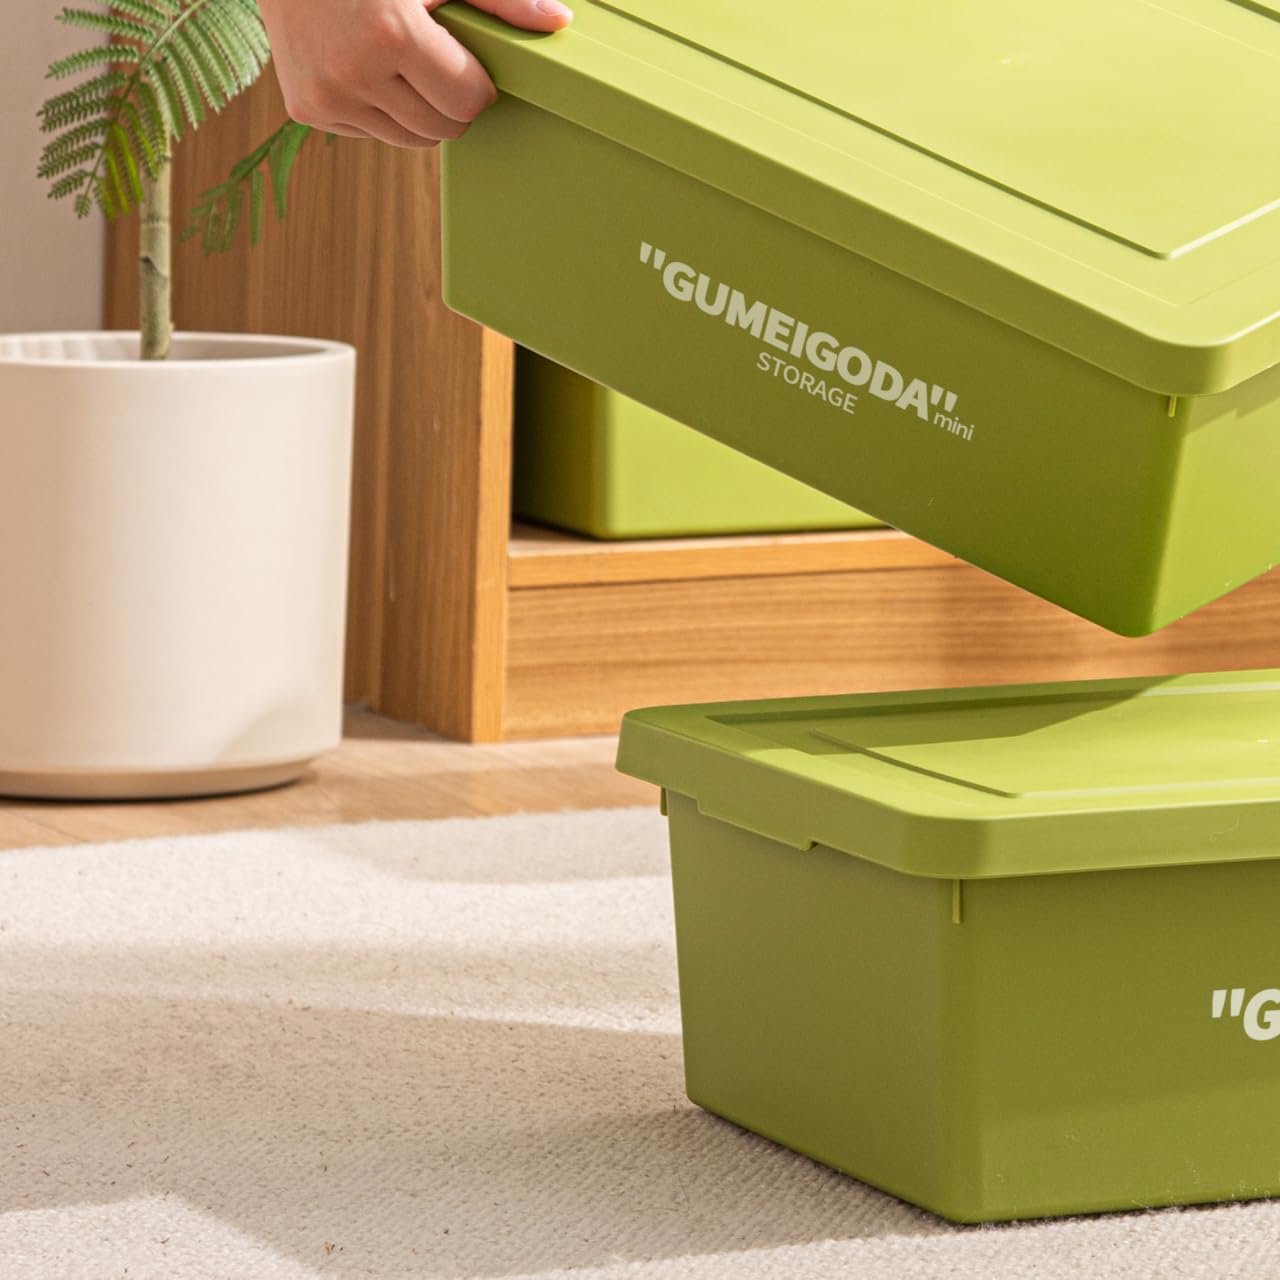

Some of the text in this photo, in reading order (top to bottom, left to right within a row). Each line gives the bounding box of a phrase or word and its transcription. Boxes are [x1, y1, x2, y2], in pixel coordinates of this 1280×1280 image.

[639, 241, 976, 441] "GUMEIGODA" mini
[756, 351, 859, 415] STORAGE
